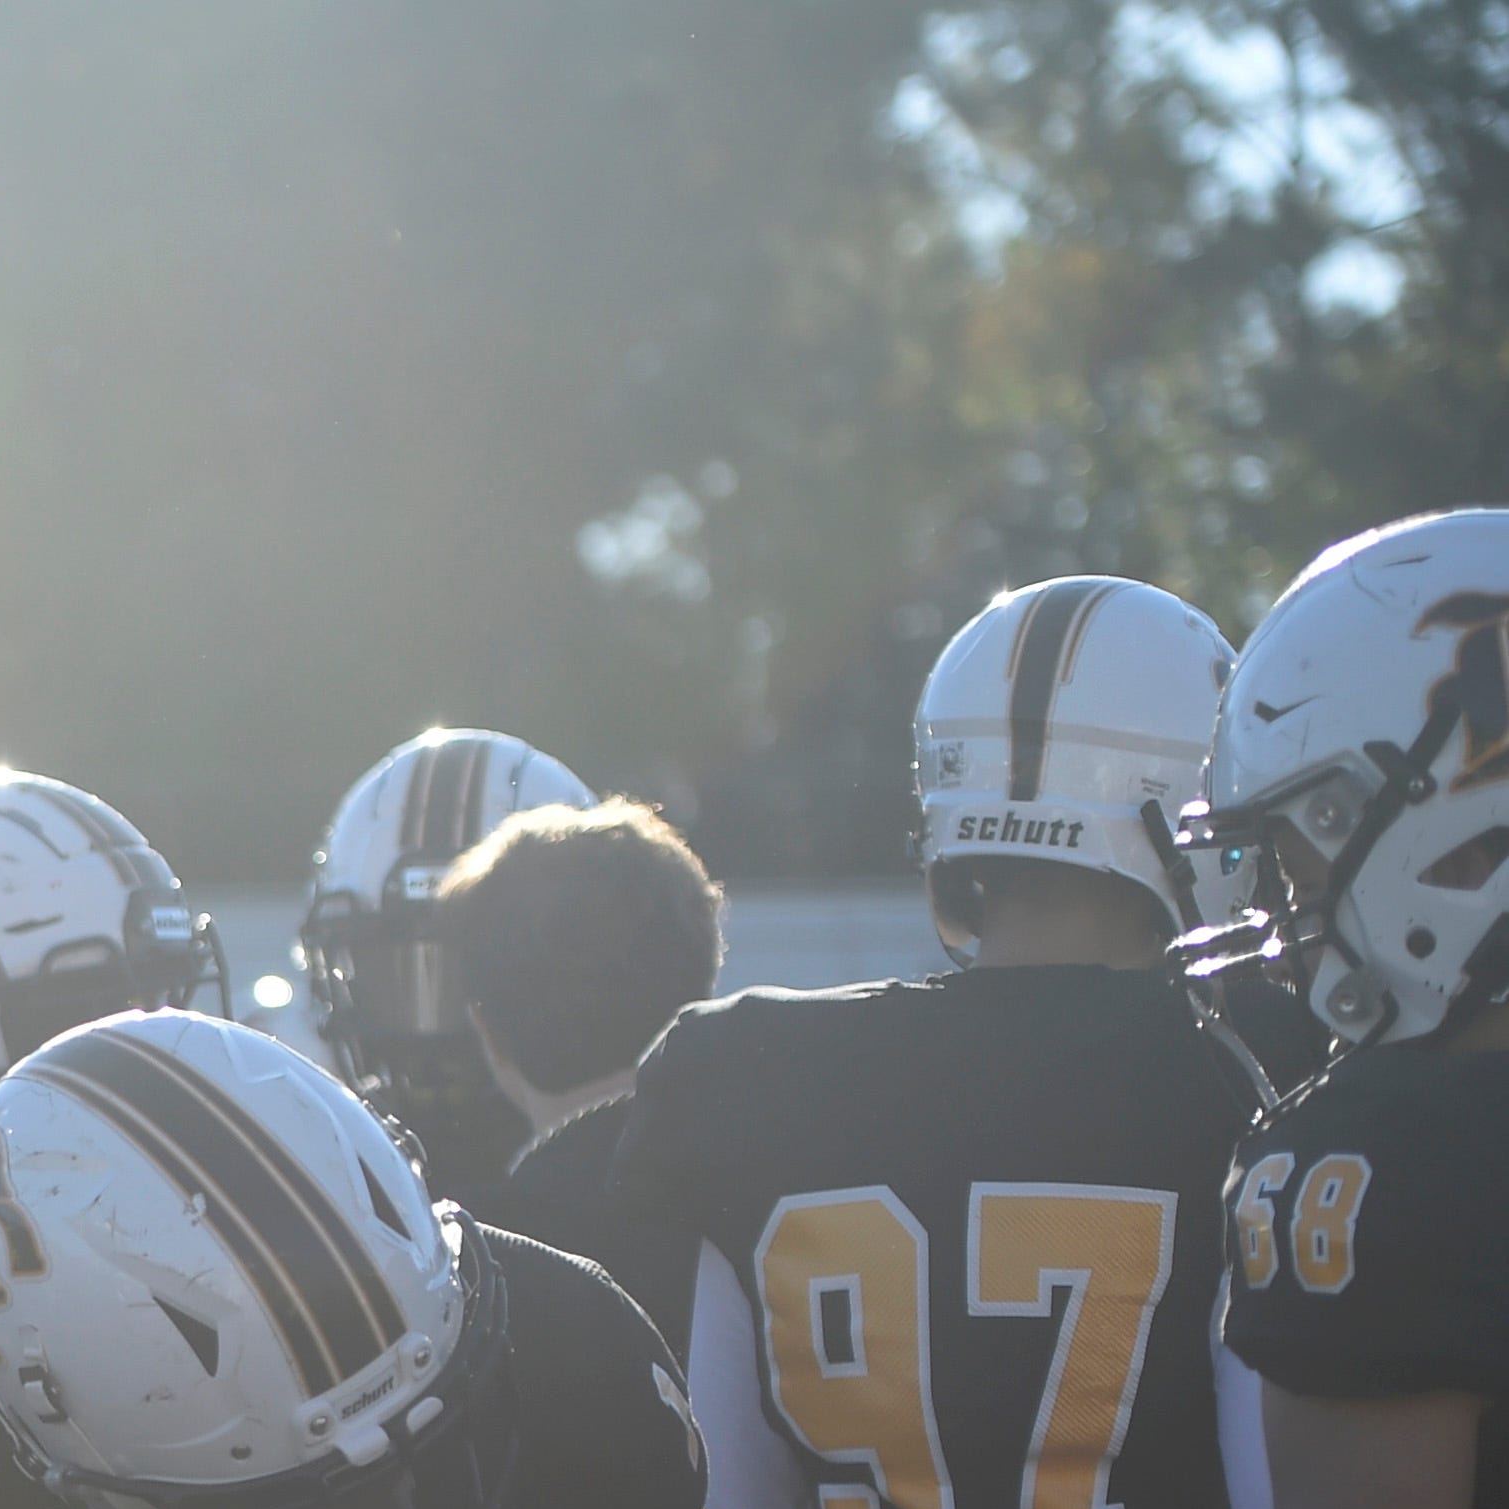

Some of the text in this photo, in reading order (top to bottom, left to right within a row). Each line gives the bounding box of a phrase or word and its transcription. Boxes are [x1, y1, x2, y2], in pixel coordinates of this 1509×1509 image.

[958, 808, 1085, 849] schutt
[1235, 1152, 1372, 1294] 68
[341, 1375, 395, 1420] schutt
